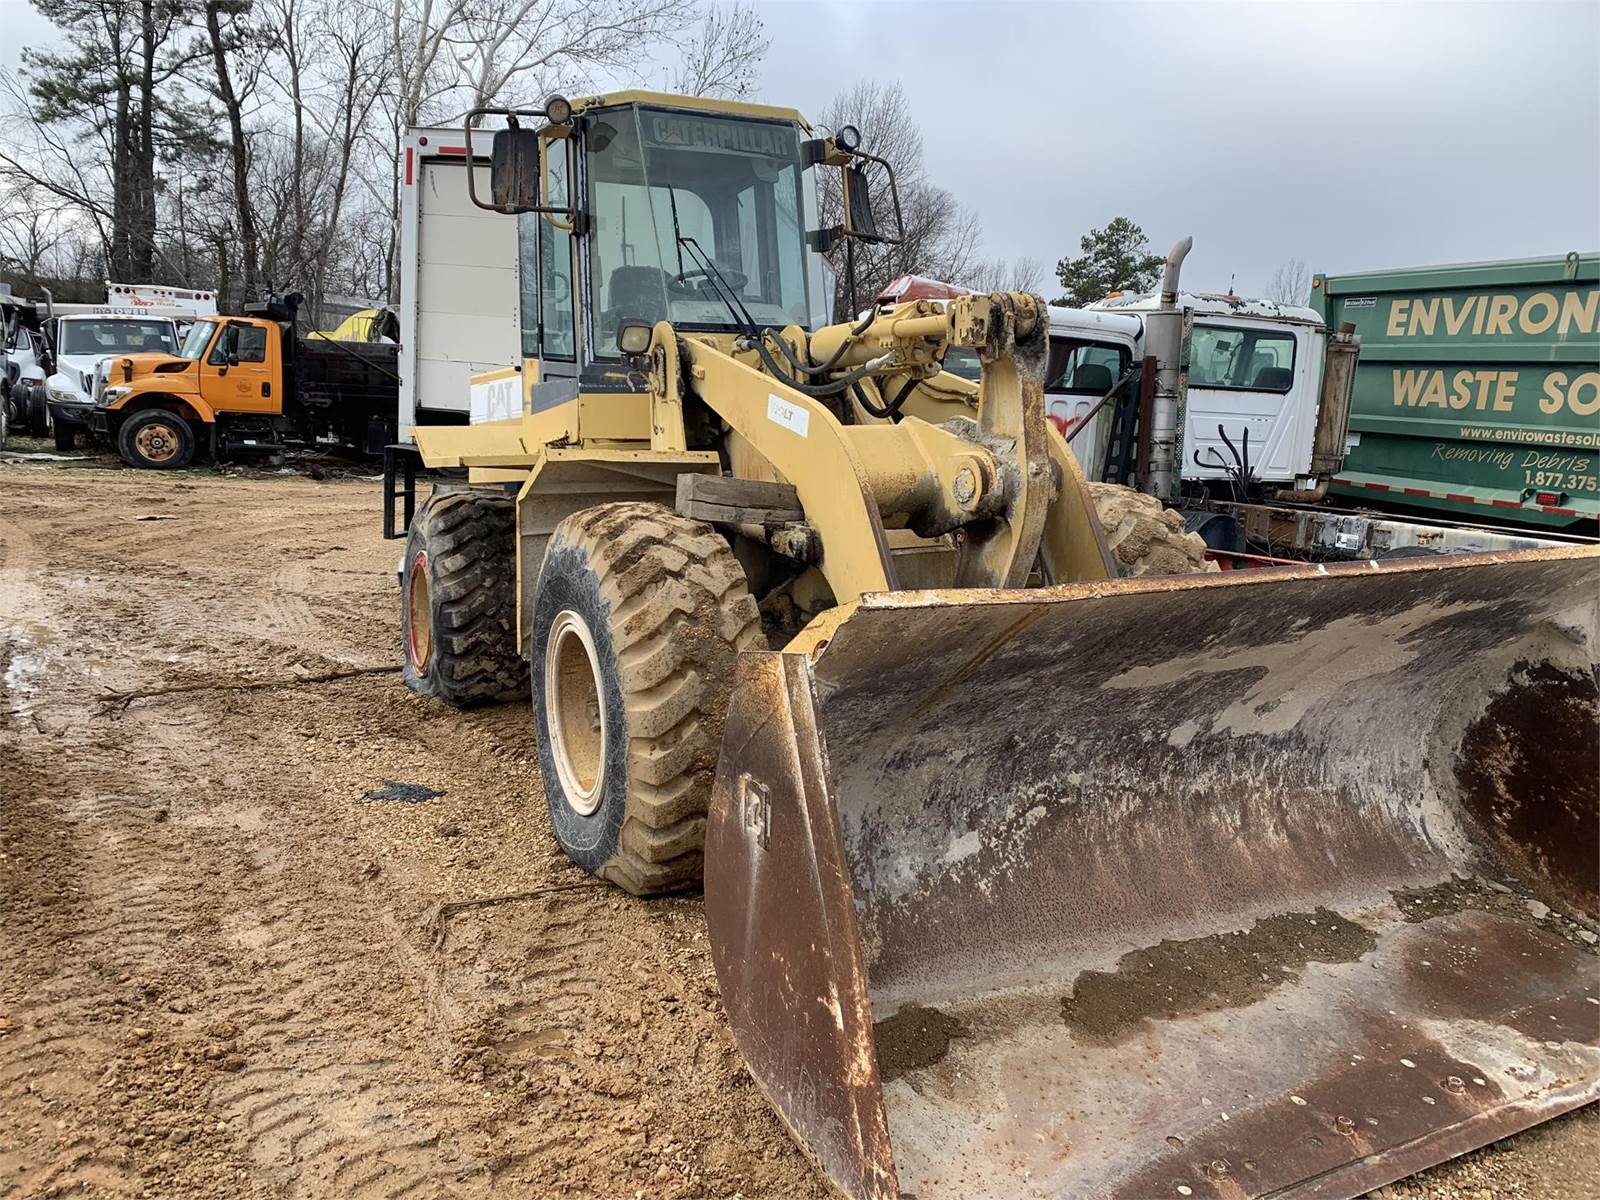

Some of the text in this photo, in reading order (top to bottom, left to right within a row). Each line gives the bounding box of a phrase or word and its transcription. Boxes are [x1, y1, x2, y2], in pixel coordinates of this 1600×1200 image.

[652, 117, 787, 155] CATERPILLAR
[1386, 290, 1600, 337] ENVIRON
[487, 382, 513, 420] CAT
[1392, 369, 1600, 416] WASTE SO
[1431, 442, 1590, 472] Removing Debris
